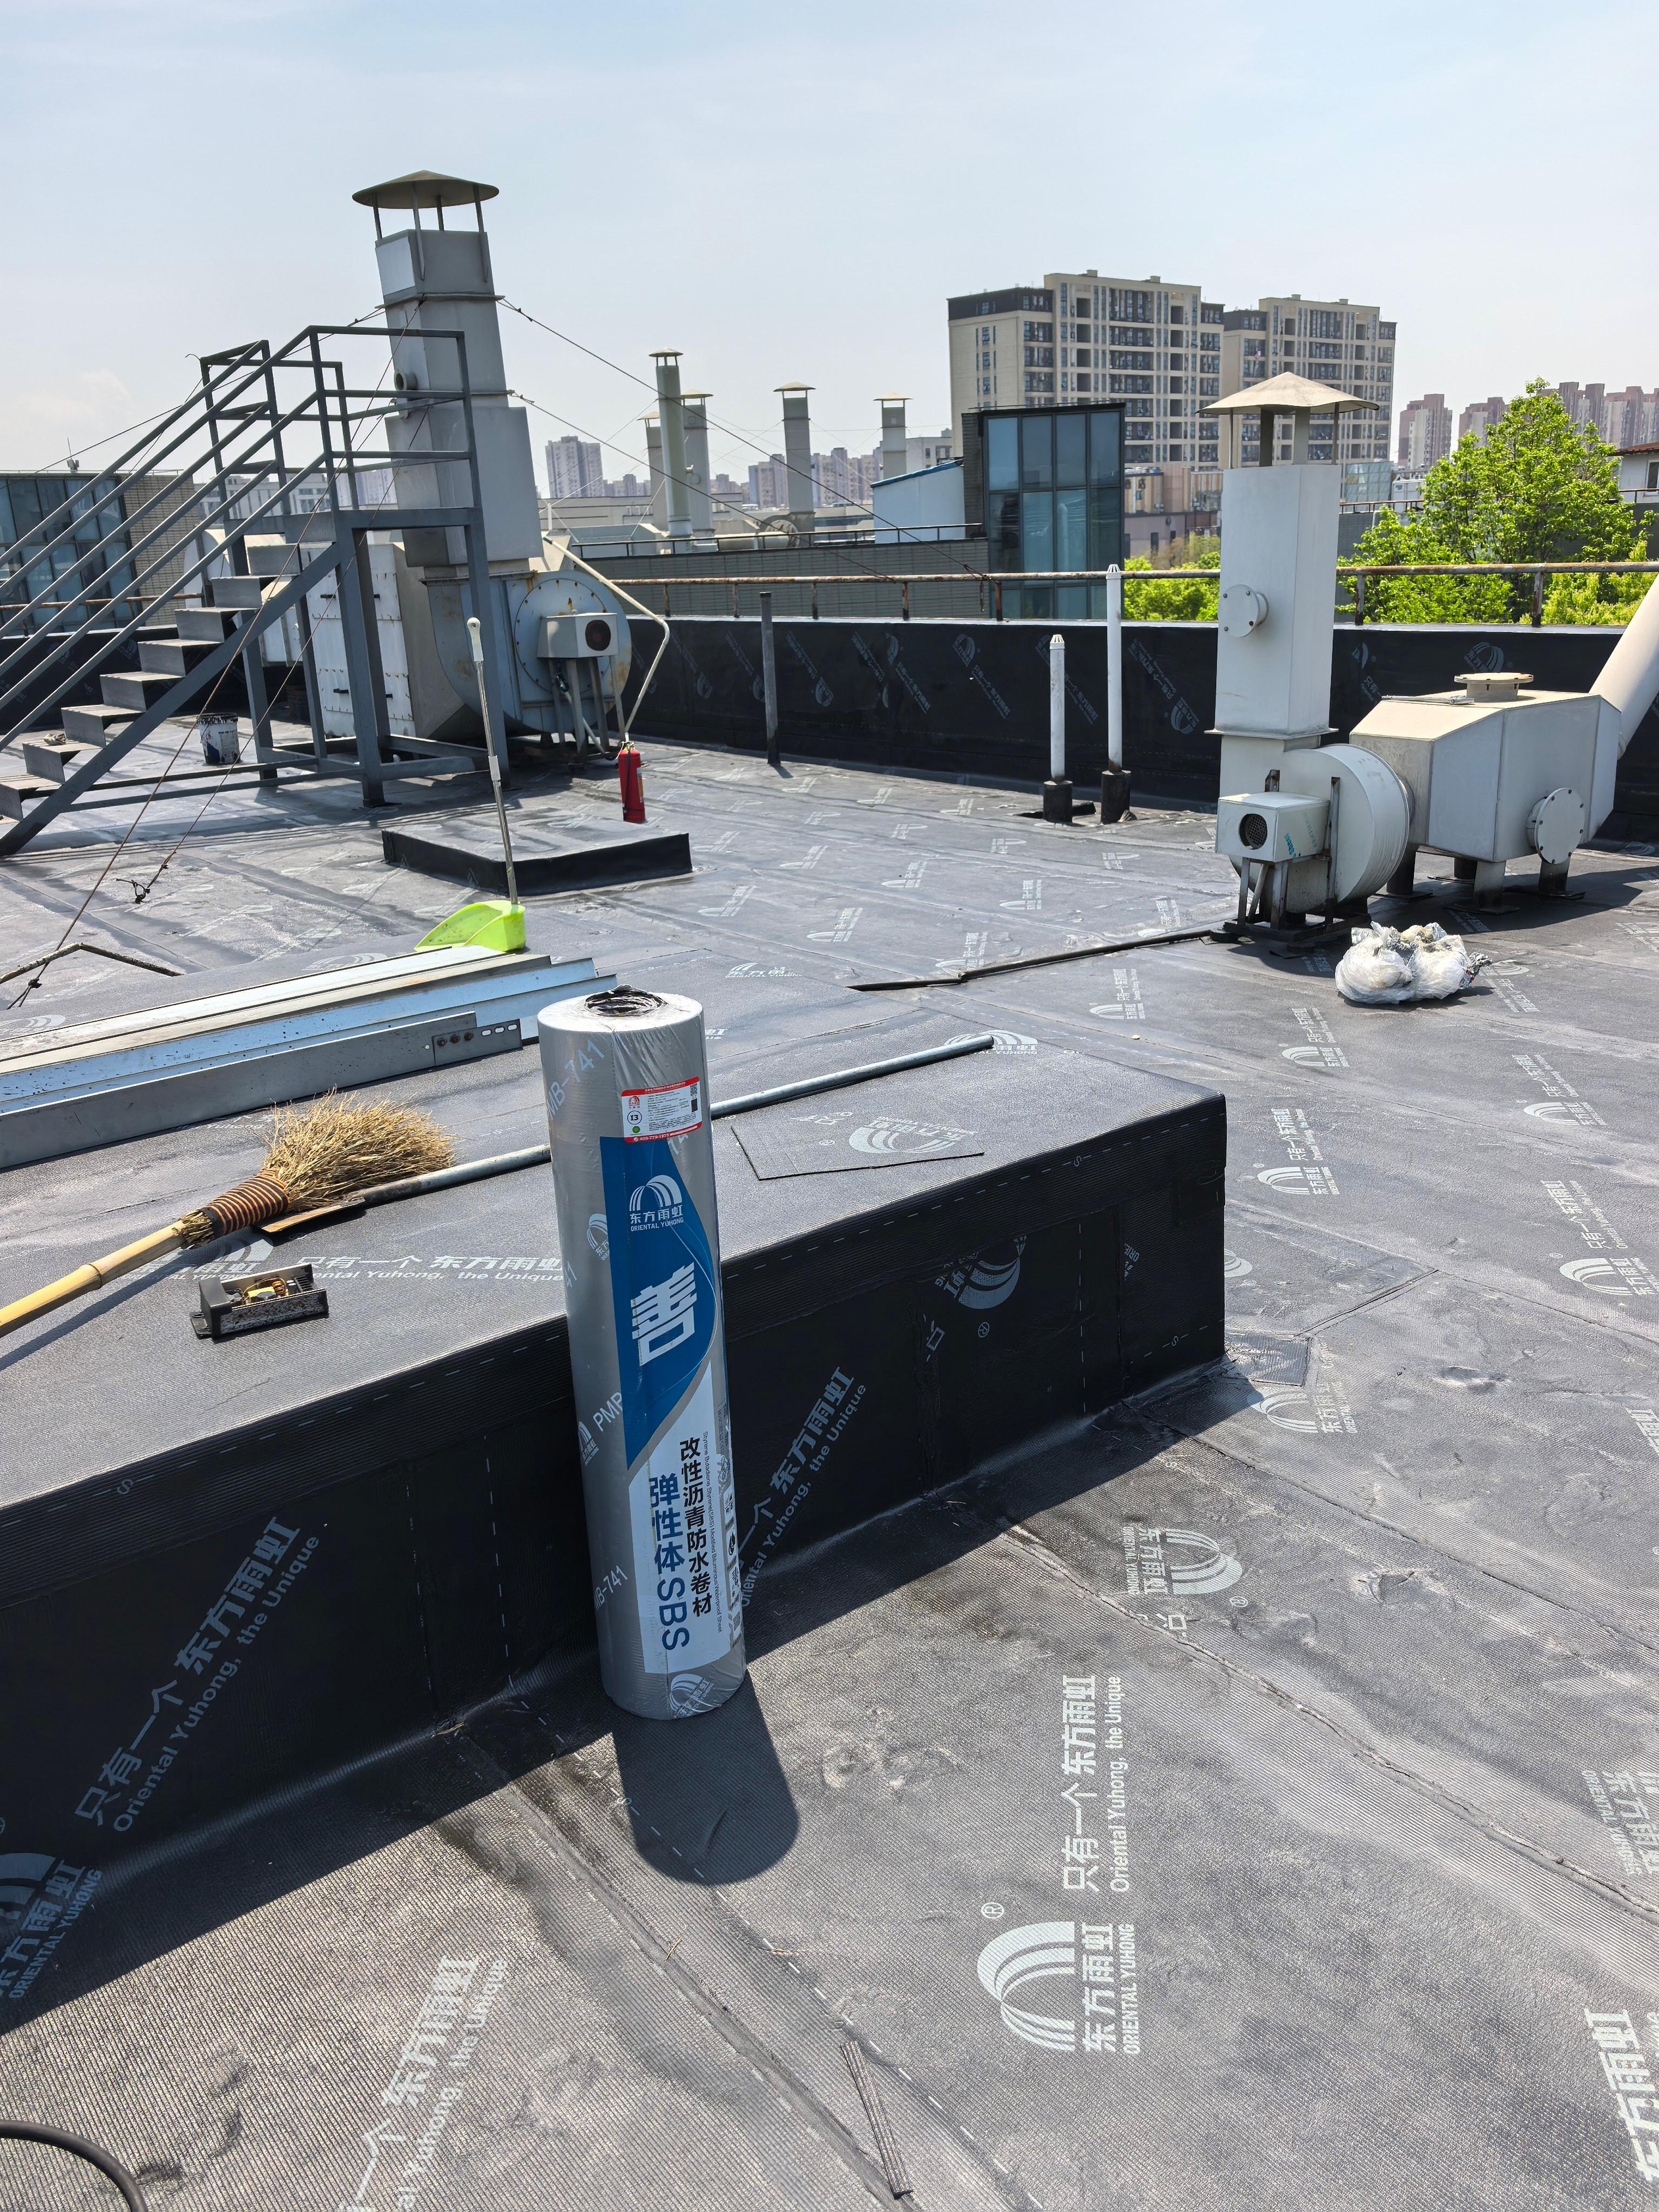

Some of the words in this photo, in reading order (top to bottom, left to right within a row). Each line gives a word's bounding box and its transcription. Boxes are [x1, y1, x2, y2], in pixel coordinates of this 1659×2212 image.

[1281, 1135, 1309, 1161] 只有一个
[1303, 1166, 1330, 1195] 东方雨虹
[630, 1205, 683, 1224] 东方雨虹
[631, 1223, 659, 1232] ORIENTAL
[661, 1217, 684, 1228] YUHONG
[1540, 1179, 1584, 1215] 东方雨虹
[1568, 1215, 1613, 1249] 只有一个
[1603, 1227, 1628, 1249] Oriental
[296, 1255, 423, 1270] 只有一个
[429, 1255, 563, 1272] 东方雨虹
[458, 1271, 489, 1280] the
[1609, 1257, 1656, 1296] 东方雨虹
[630, 1262, 697, 1367] 善
[768, 1366, 854, 1495] 东方雨虹
[648, 1472, 685, 1575] 弹性体
[679, 1437, 713, 1617] 改性沥青防水卷材
[741, 1553, 766, 1608] Oriental
[763, 1481, 812, 1547] Yuhong,
[810, 1446, 831, 1473] the
[826, 1384, 866, 1442] Unique
[1138, 1527, 1169, 1595] 东方雨虹
[657, 1577, 691, 1650] SBS
[74, 1678, 184, 1826] 只有一个
[173, 1516, 301, 1675] 东方雨虹
[112, 1745, 179, 1832] Oriental
[169, 1658, 242, 1742] Yuhong,
[236, 1612, 268, 1645] the
[261, 1536, 320, 1608] Unique
[1104, 1676, 1122, 1723] Unique
[1061, 1675, 1095, 1776] 东方雨虹
[1104, 1725, 1123, 1749] the
[1105, 1756, 1129, 1820] Yuhong,
[1060, 1782, 1100, 1891] 只有一个
[1109, 1824, 1130, 1892] Oriental
[8, 1931, 66, 1999] ORIENTAL
[56, 1868, 103, 1929] YUHONG
[1122, 1922, 1135, 1975] YUHONG
[448, 2035, 479, 2068] the
[464, 1958, 509, 2028] Unique
[1081, 1921, 1116, 2053] 东方雨虹
[1121, 1978, 1141, 2054] ORIENTAL
[381, 1954, 480, 2106] 东方雨虹
